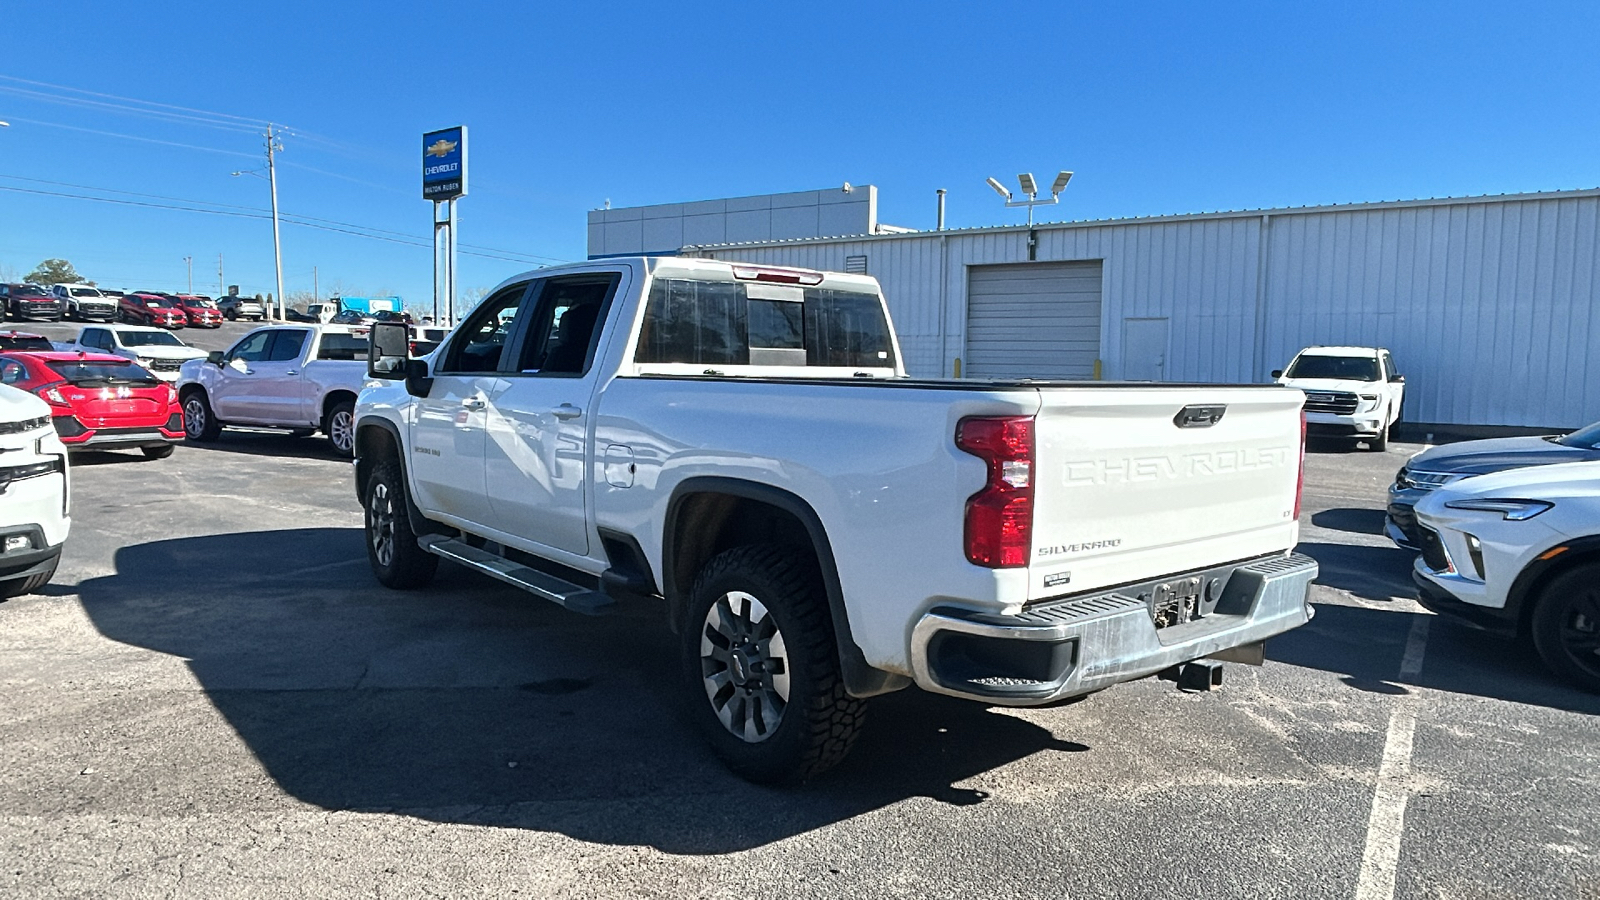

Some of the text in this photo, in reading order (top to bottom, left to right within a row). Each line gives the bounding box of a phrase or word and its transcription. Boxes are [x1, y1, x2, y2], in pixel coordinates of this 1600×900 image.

[425, 163, 458, 175] CHEVROLET
[1062, 446, 1291, 487] CHEVROLET
[1038, 538, 1121, 556] SILVERADO
